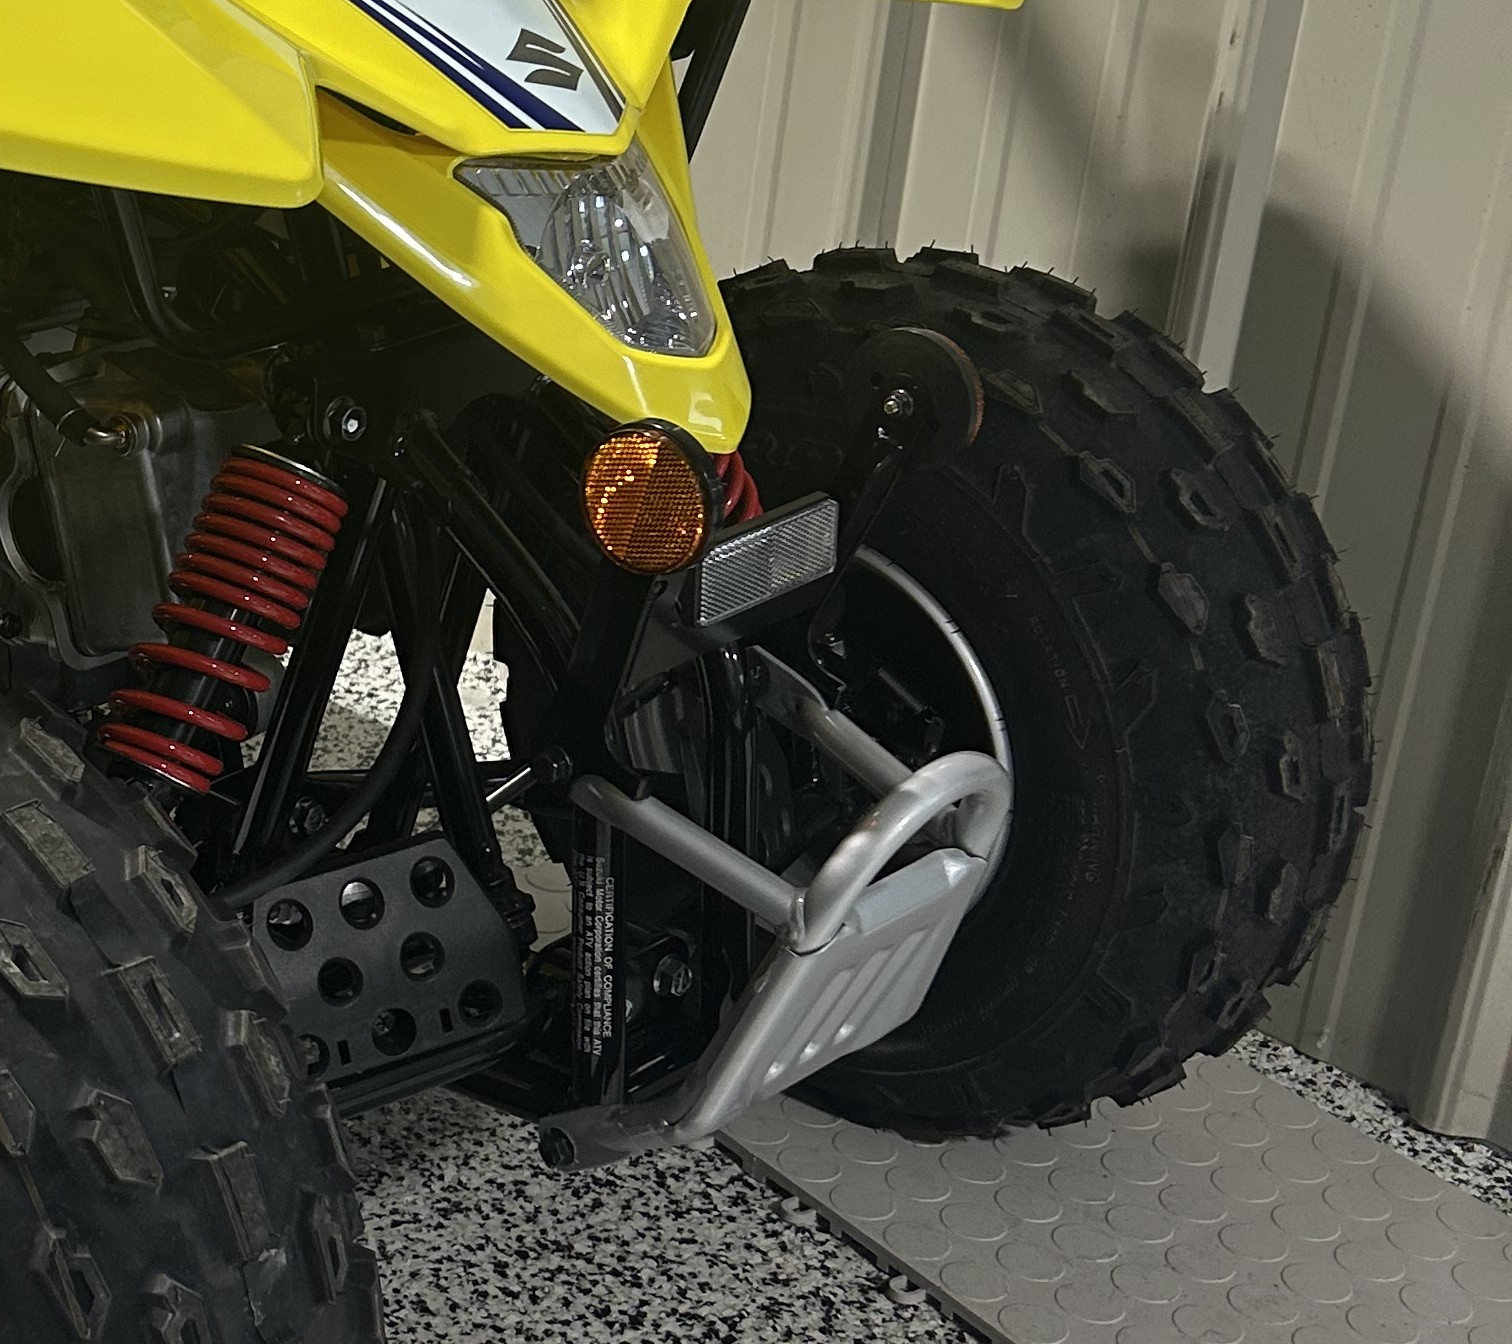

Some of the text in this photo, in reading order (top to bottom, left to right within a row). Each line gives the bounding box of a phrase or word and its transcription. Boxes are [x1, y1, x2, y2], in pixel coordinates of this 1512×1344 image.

[602, 876, 615, 1039] CERTIFICATION OF COMPLIANCE
[592, 1038, 602, 1056] ATV
